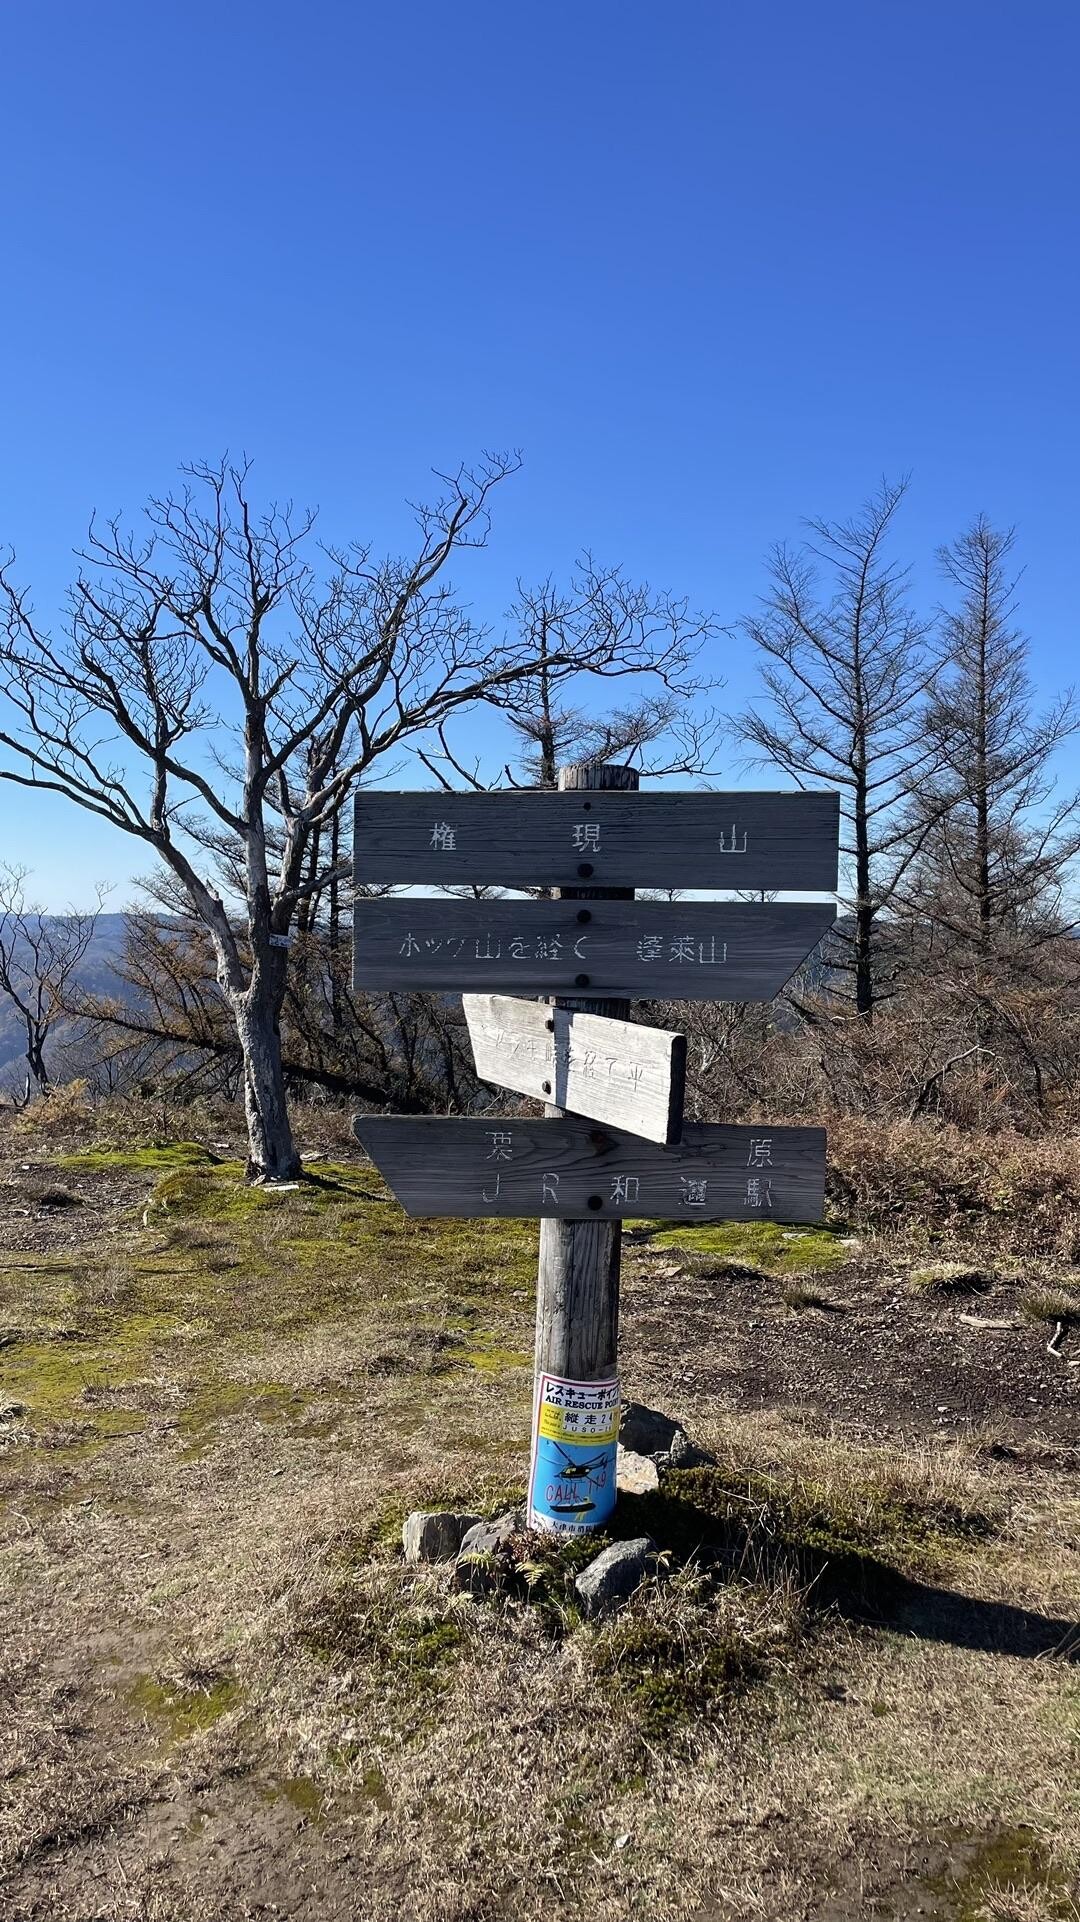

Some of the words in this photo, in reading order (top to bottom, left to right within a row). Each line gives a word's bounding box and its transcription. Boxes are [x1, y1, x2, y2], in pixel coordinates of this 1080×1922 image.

[545, 1395, 562, 1406] AIR
[564, 1399, 603, 1410] RESCUE
[546, 1484, 578, 1502] CALL
